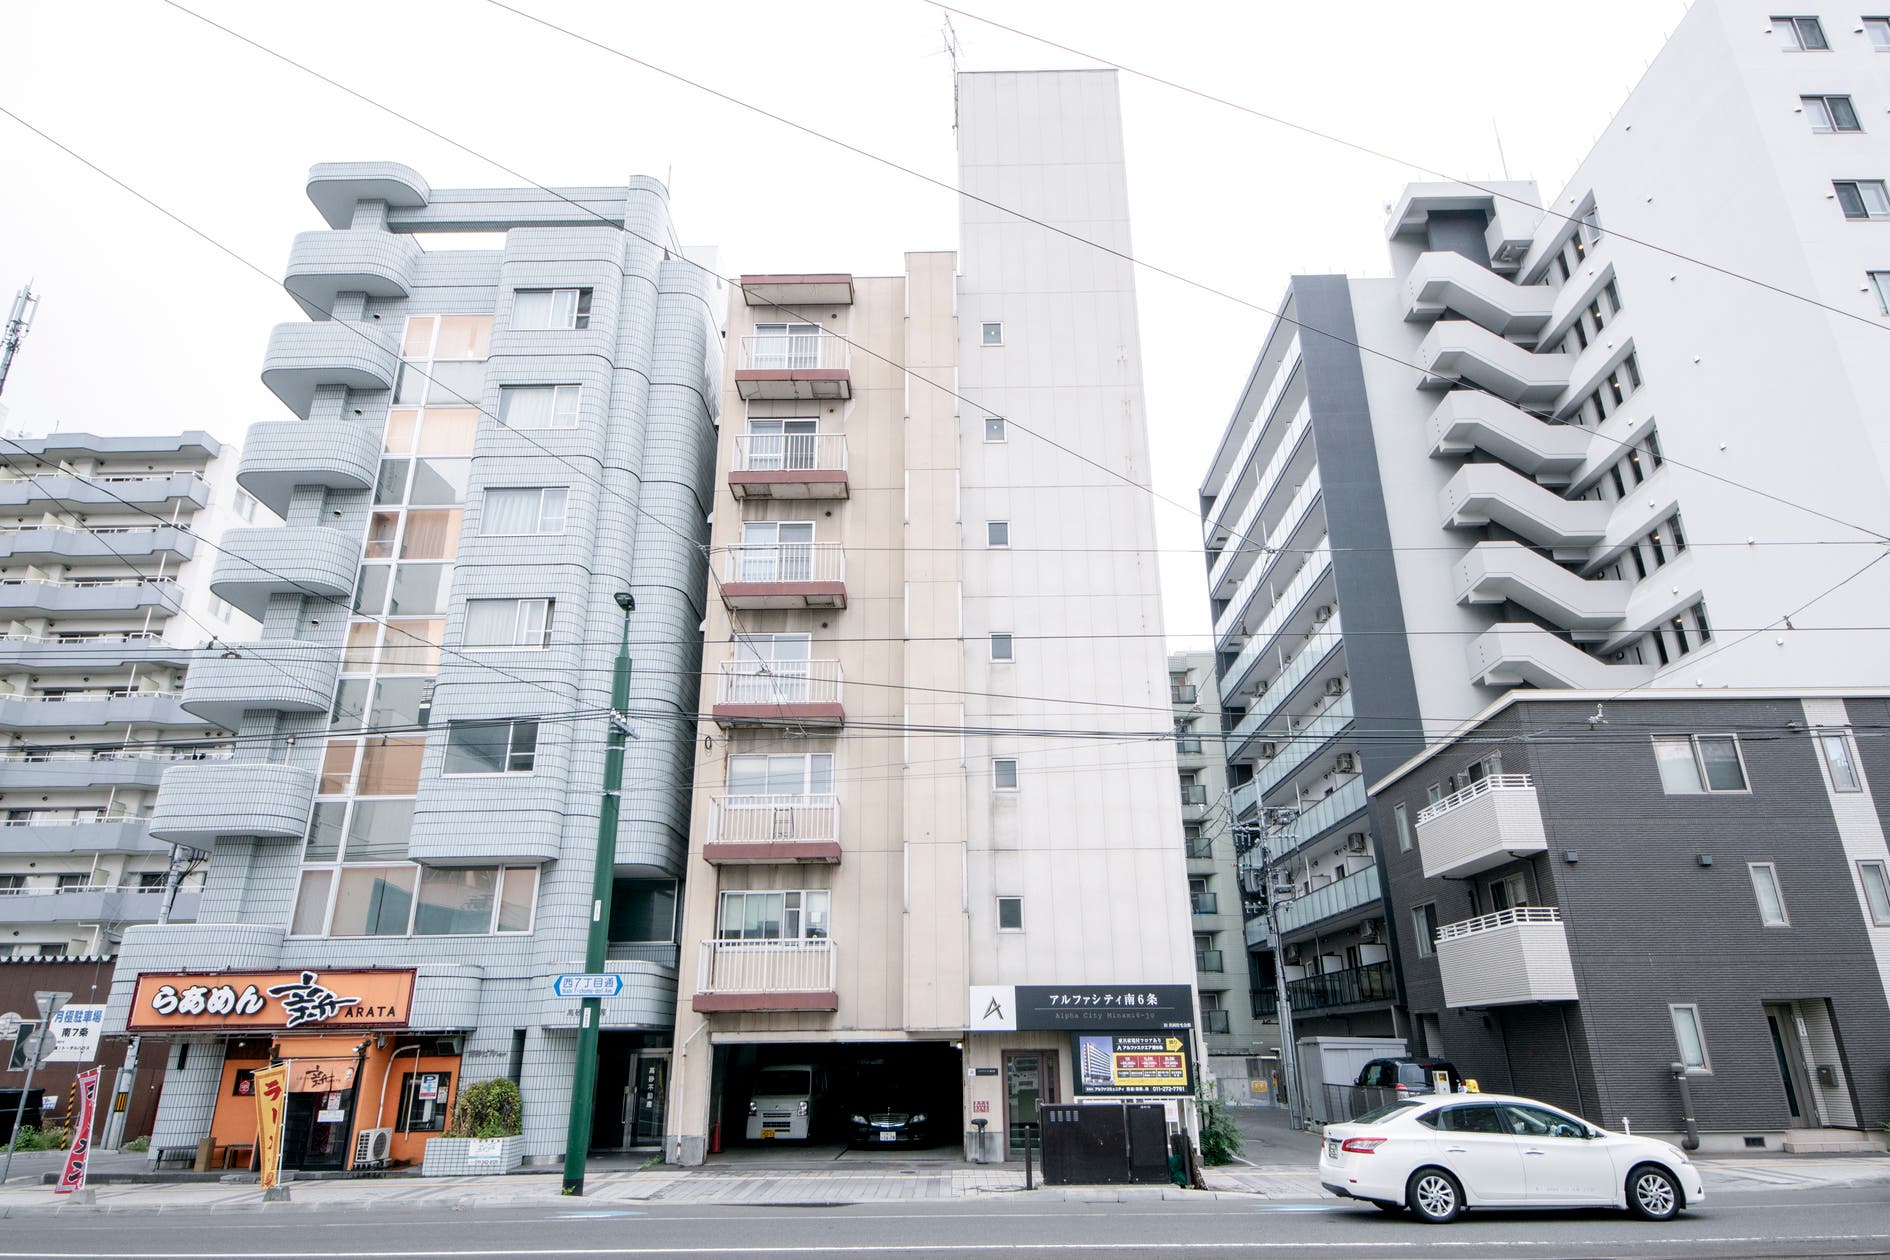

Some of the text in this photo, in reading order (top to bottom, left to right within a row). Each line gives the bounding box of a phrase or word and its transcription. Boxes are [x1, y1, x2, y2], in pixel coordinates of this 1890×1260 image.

[563, 978, 614, 988] 西7丁目通
[152, 984, 267, 1016] らあめん
[1049, 993, 1158, 1006] アルファシティ南6条
[55, 1010, 103, 1023] 月極駐車場
[345, 1006, 396, 1017] ARATA
[566, 1008, 607, 1017] 高砂産
[1055, 1012, 1079, 1020] Alpha
[1083, 1012, 1103, 1020] City
[62, 1027, 89, 1037] 南7条
[424, 1075, 436, 1083] P
